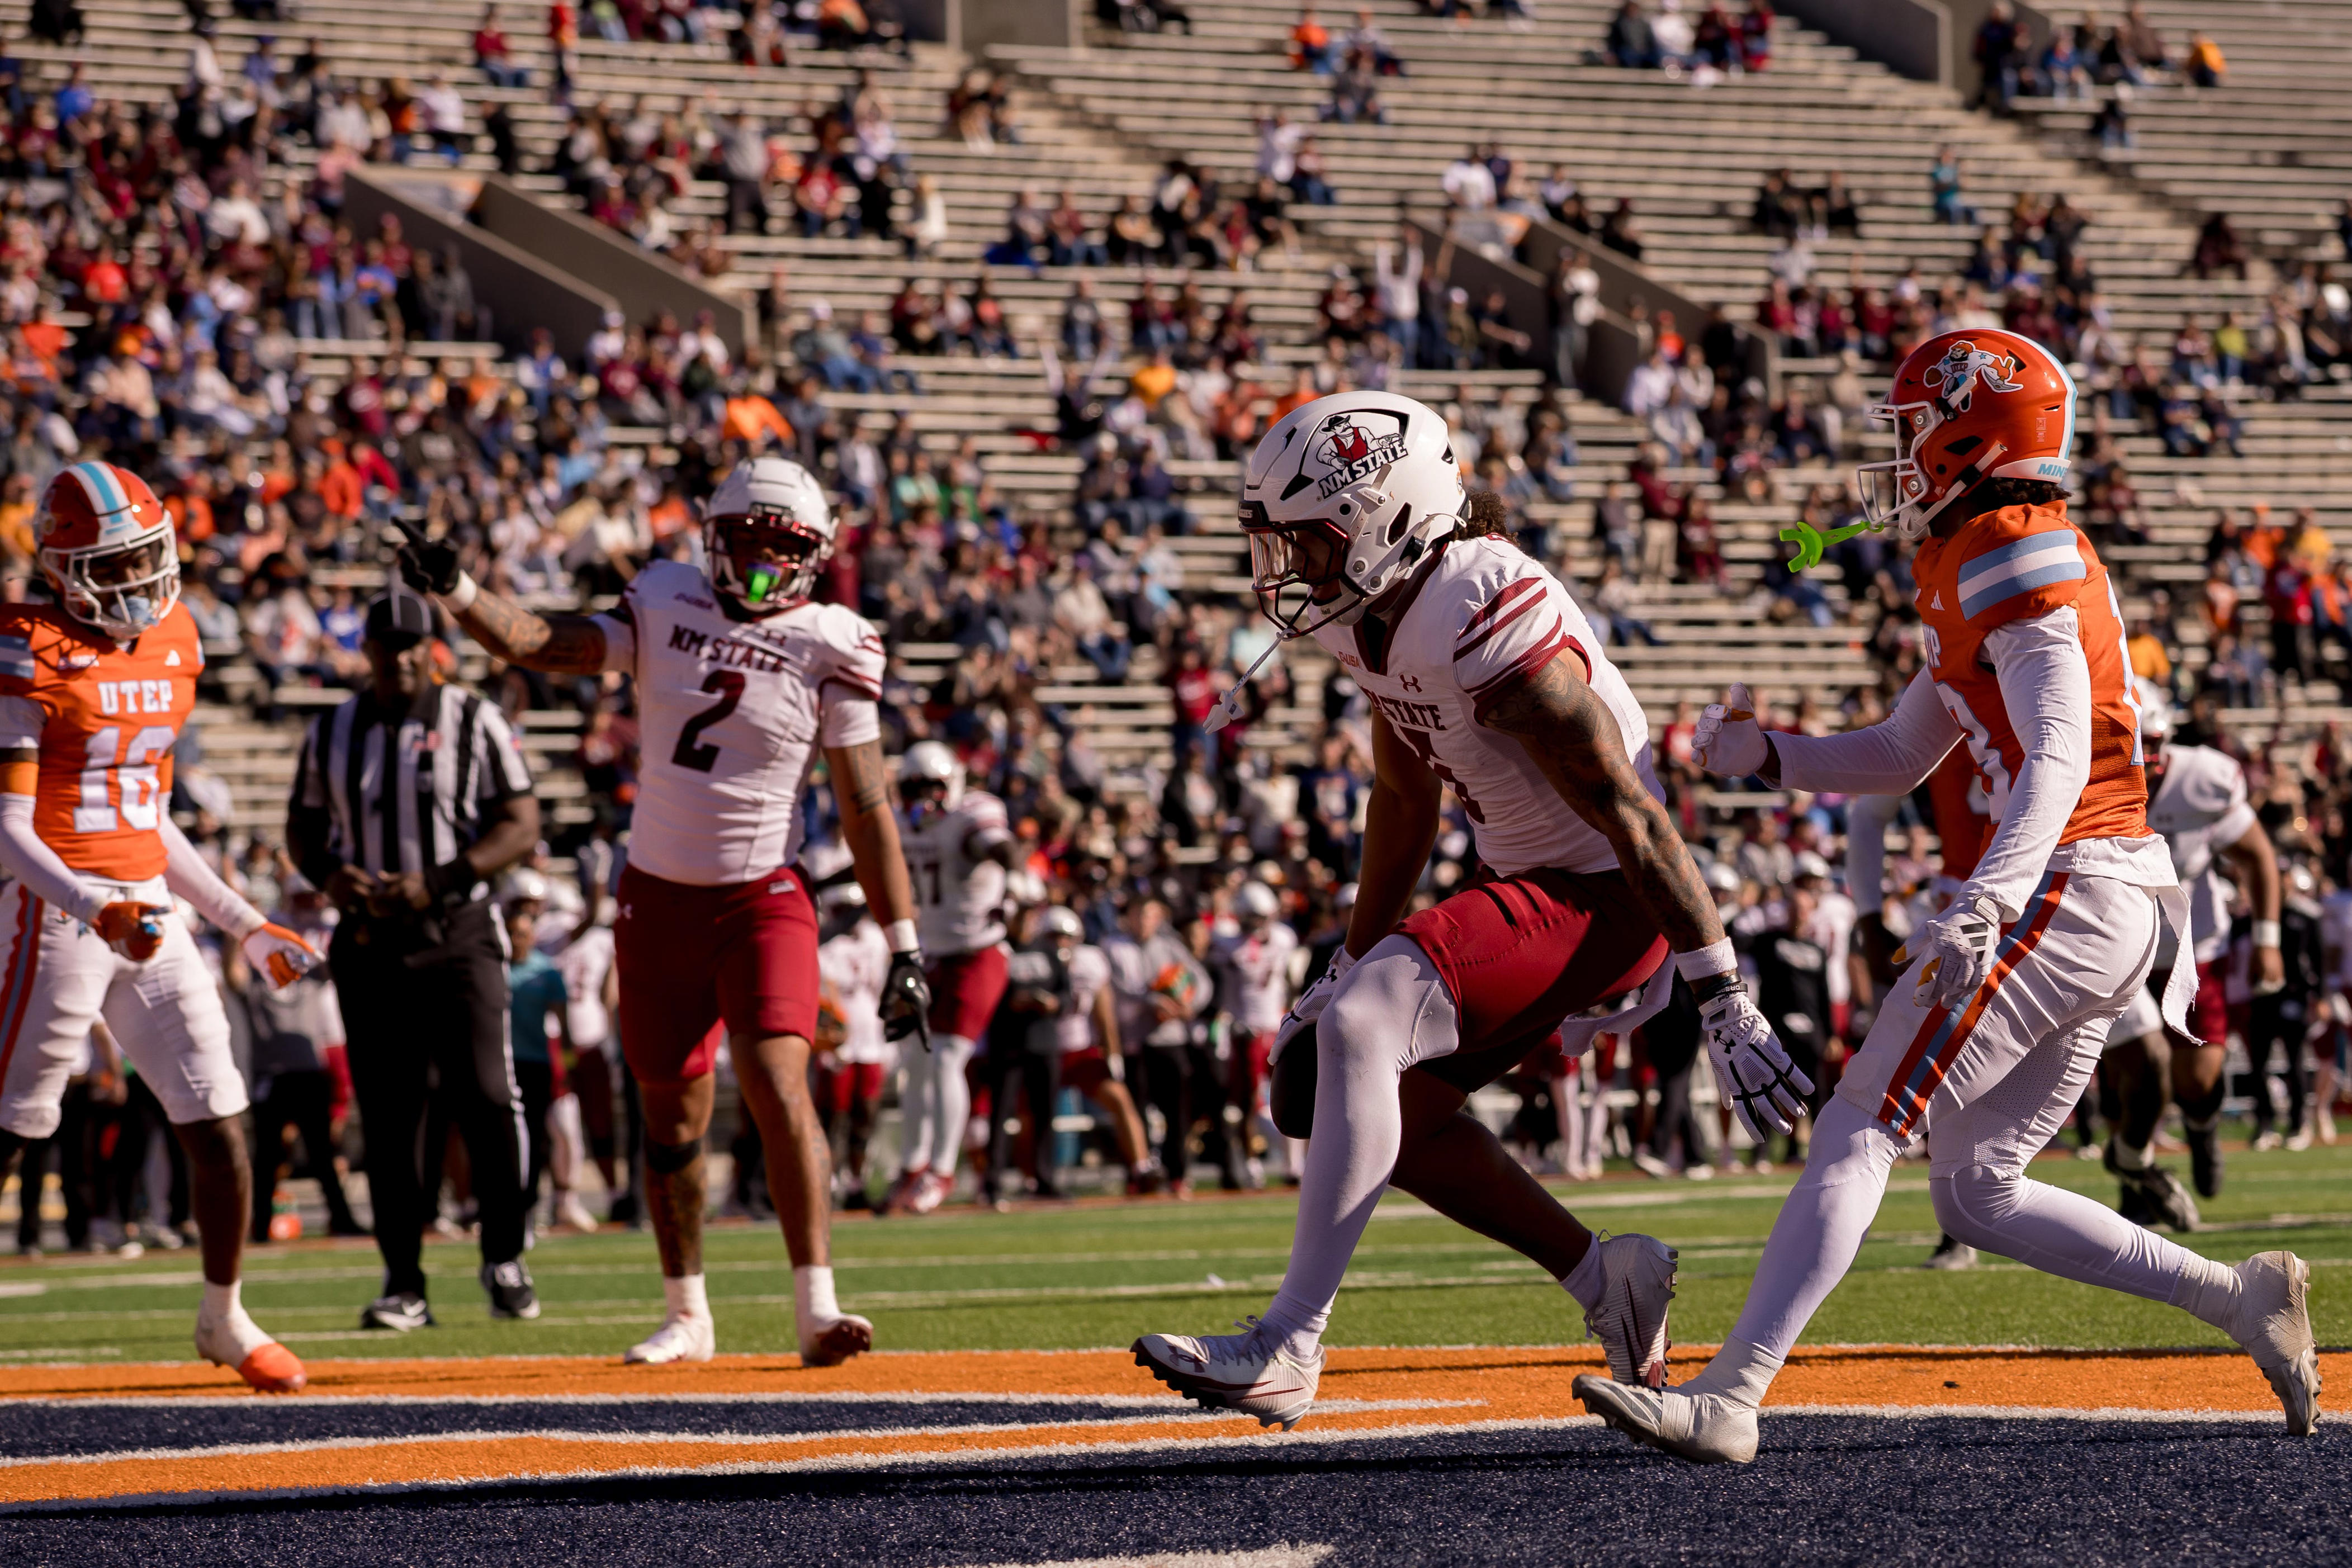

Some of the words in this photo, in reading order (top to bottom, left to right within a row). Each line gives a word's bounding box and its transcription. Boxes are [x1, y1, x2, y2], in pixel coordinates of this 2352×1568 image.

[1319, 466, 1353, 497] NM
[1351, 439, 1408, 479] STATE
[668, 624, 708, 657] NM
[97, 679, 173, 716] UTEP
[671, 668, 746, 773] 2
[1378, 695, 1449, 731] STATE
[72, 725, 178, 833] 16
